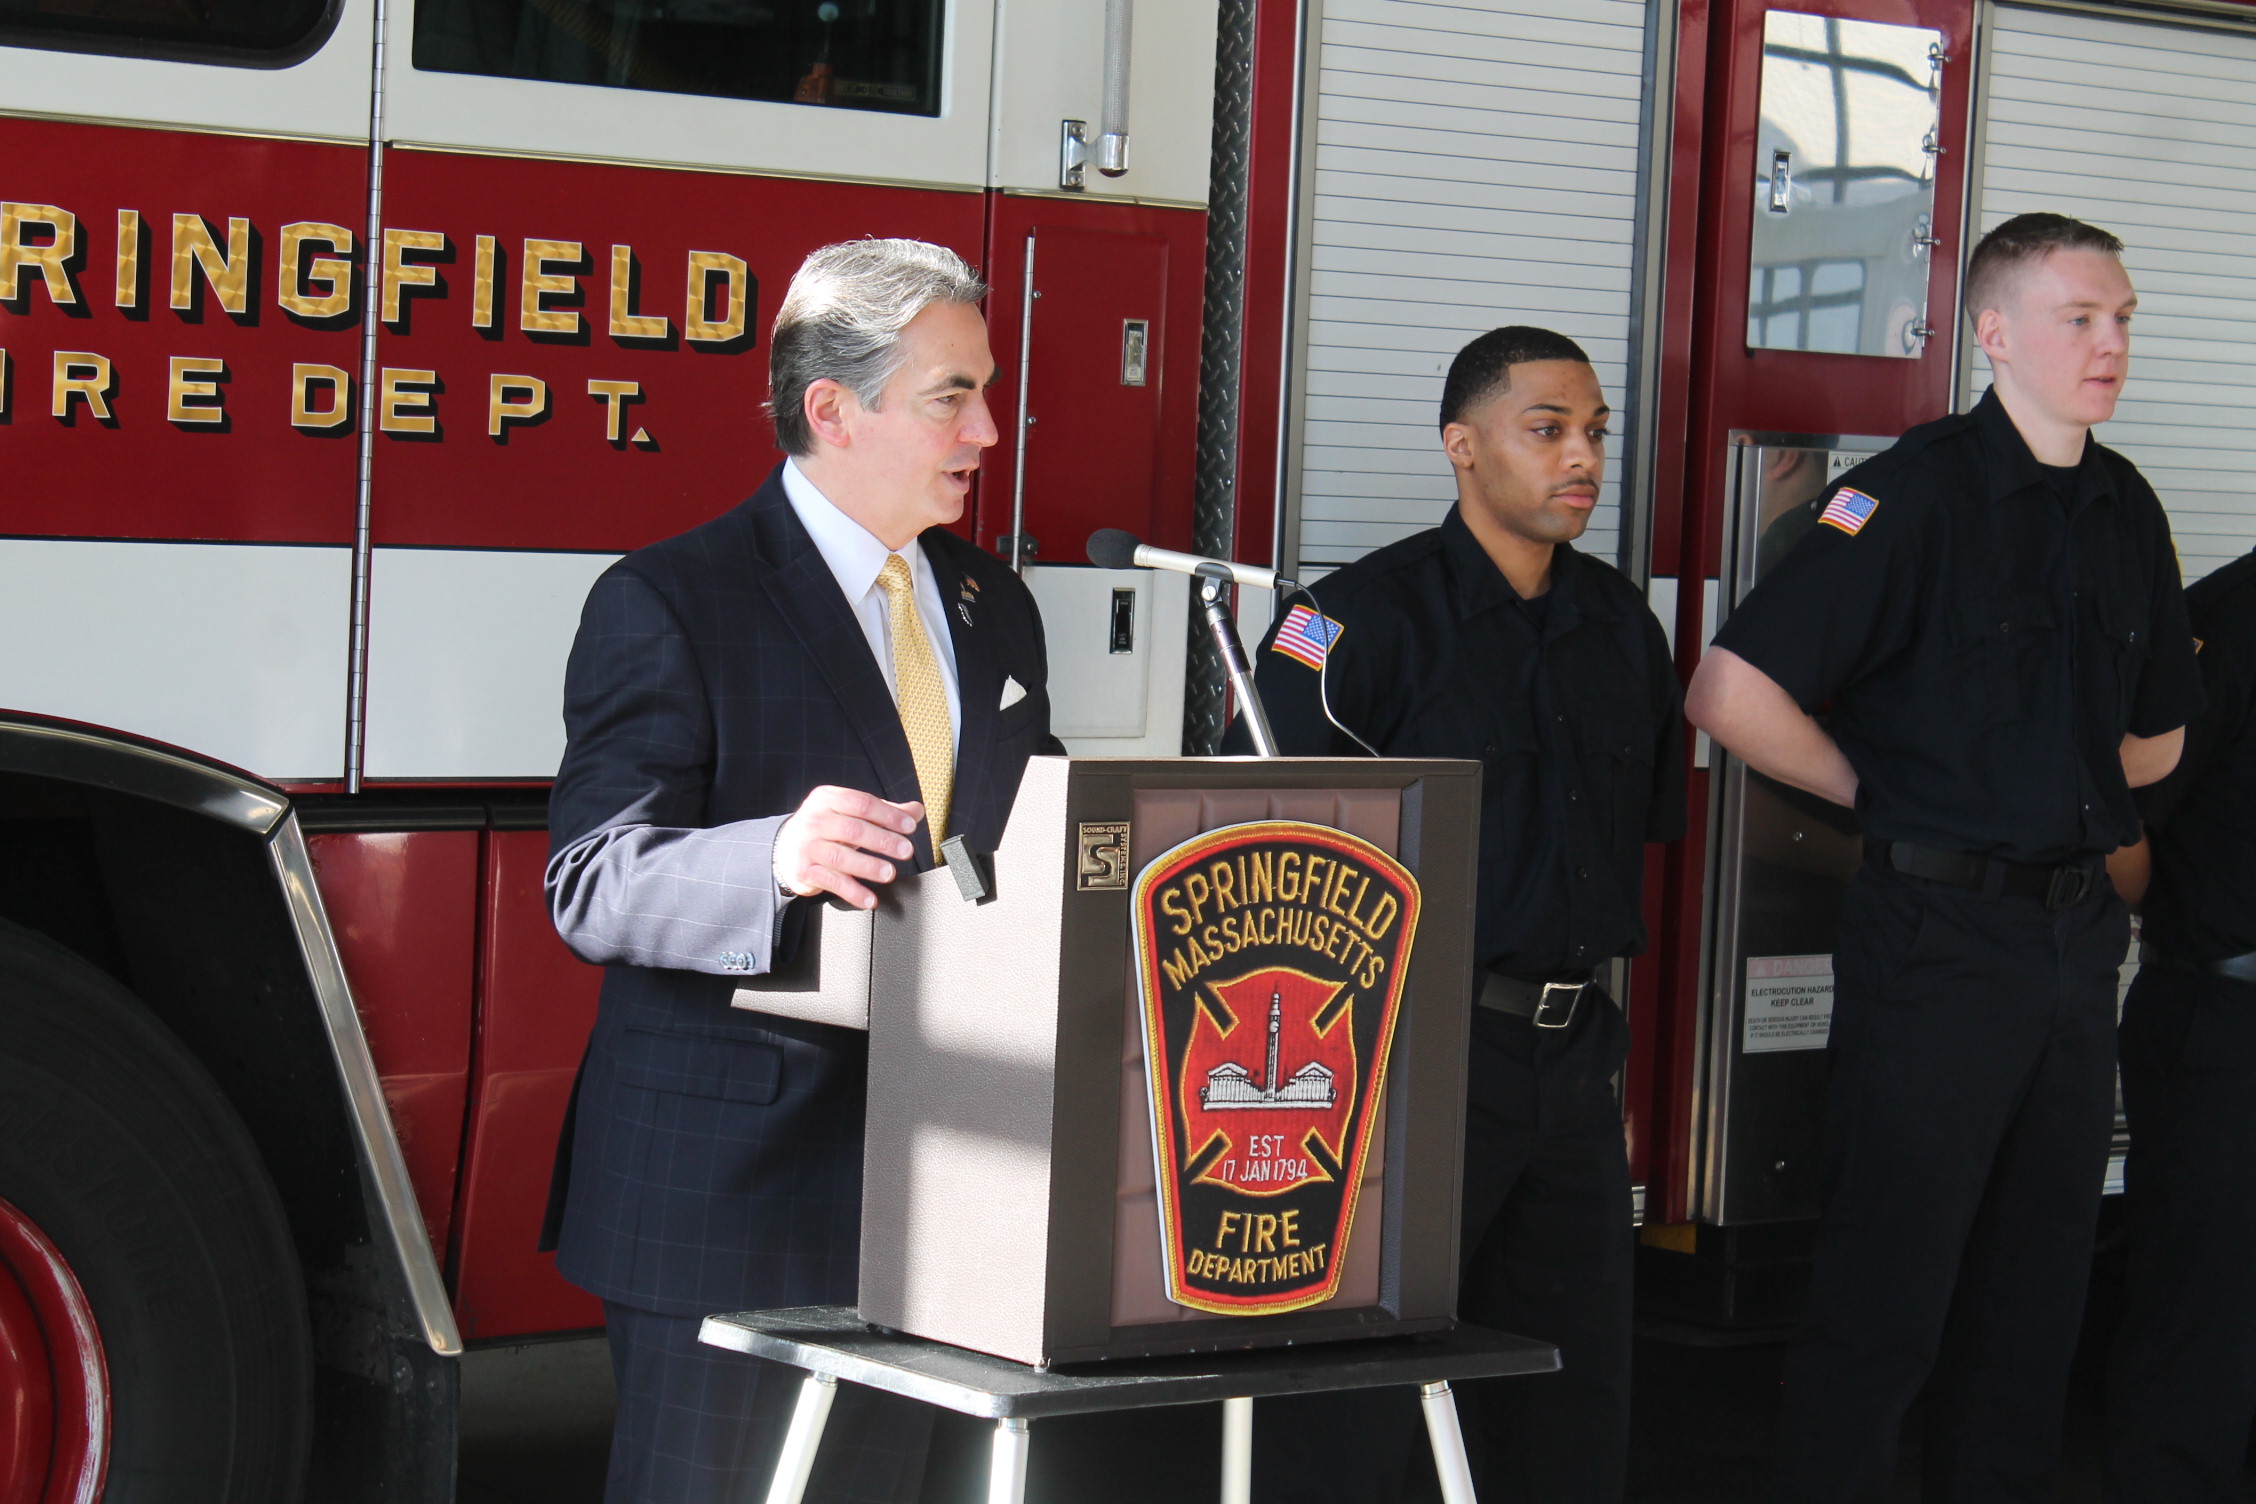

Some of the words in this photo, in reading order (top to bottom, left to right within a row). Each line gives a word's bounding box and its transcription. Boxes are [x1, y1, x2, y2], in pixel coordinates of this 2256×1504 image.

[0, 201, 749, 344] RINGFIELD
[291, 361, 651, 443] DEPT.
[1082, 826, 1127, 834] SOUND-CRAFT
[1160, 851, 1398, 941] SPRINGFIELD
[1162, 906, 1385, 991] MASSACHUSETTS
[1751, 987, 1805, 997] ELECTROCUTION
[1807, 985, 1834, 994] HAZARD
[1770, 998, 1790, 1008] KEEP
[1790, 997, 1814, 1007] CLEAR
[1249, 1134, 1285, 1158] EST
[1222, 1159, 1237, 1181] 17
[1240, 1159, 1271, 1182] JAN
[1273, 1158, 1308, 1181] 1794
[1216, 1209, 1300, 1253] FIRE
[1186, 1243, 1326, 1284] DEPARTMENT
